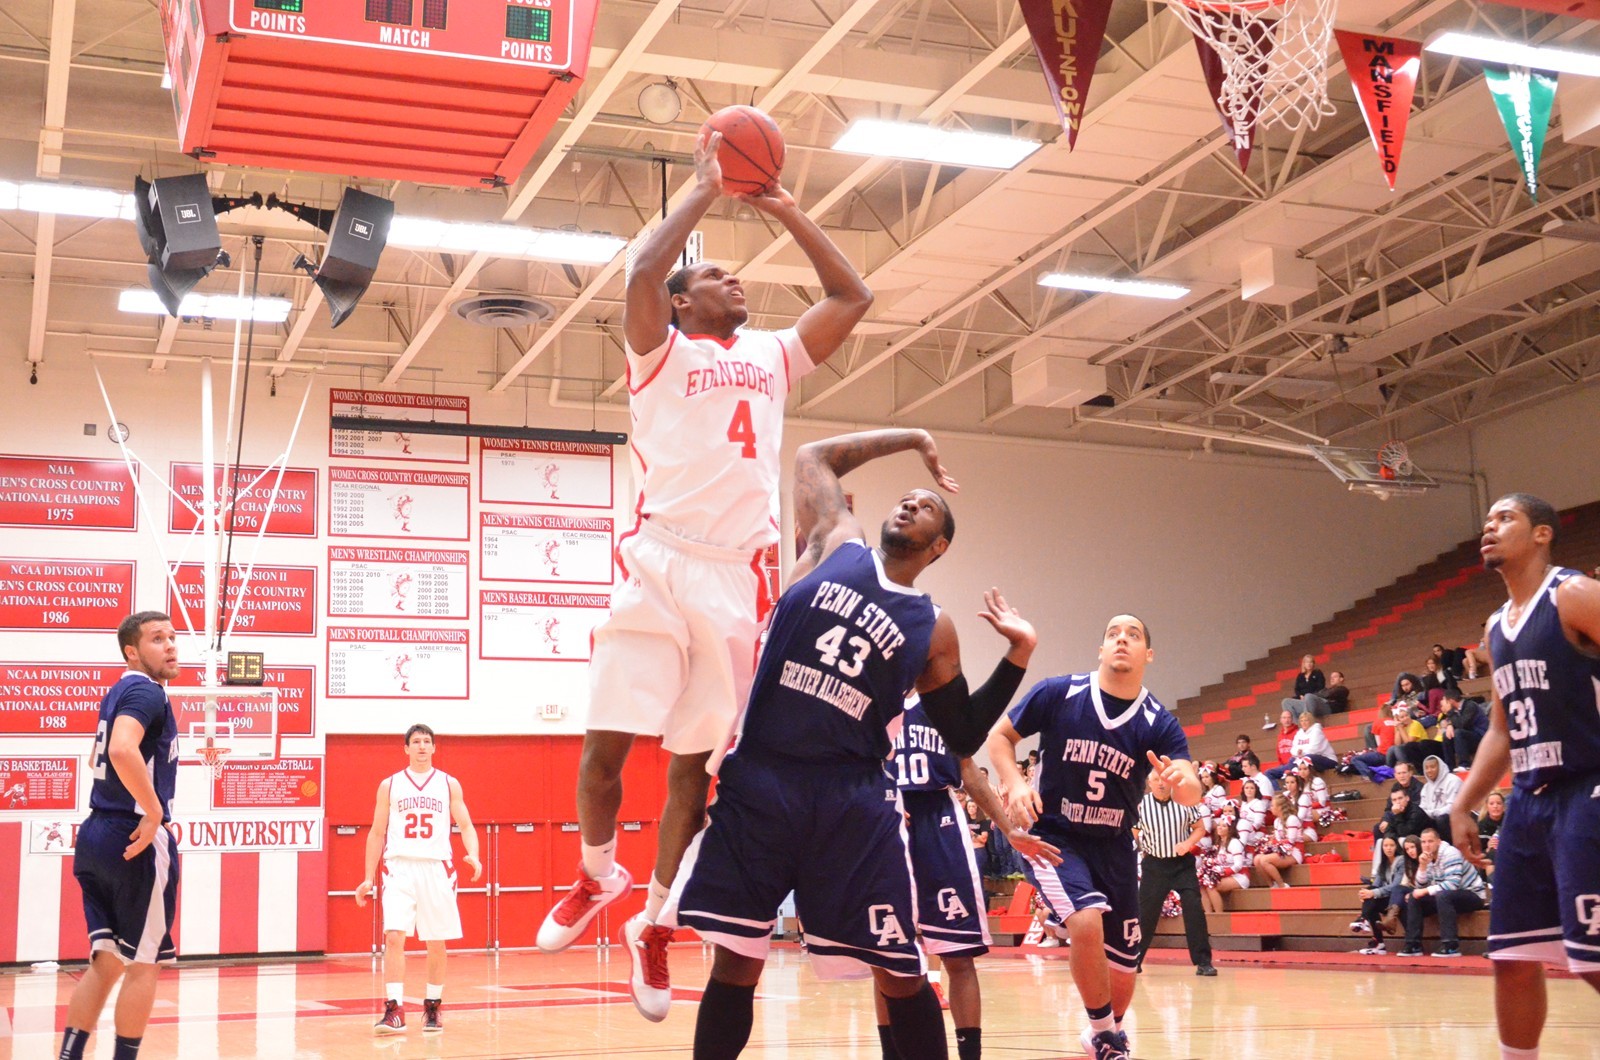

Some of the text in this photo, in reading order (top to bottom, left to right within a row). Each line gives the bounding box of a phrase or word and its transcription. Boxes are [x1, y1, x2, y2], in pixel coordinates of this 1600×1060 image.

[251, 11, 306, 33] POINTS
[380, 26, 430, 48] MATCH
[501, 40, 552, 62] POINTS
[1052, 0, 1080, 130] KUTZTOWN
[1363, 39, 1396, 174] MANSFIELD
[685, 360, 774, 401] EDINBORO
[333, 390, 467, 408] WOMEN'S CROSS COUNTRY CHAMPIONSHIPS
[727, 400, 757, 459] 4
[483, 438, 610, 454] WOMEN'S TENNIS CHAMPIONSHIPS
[48, 464, 75, 475] NAIA
[331, 469, 468, 485] WOMEN CROSS COUNTRY CHAMPIONSHIPS
[0, 477, 126, 492] EN'S CROSS COUNTRY
[55, 493, 120, 505] CHAMPIONS
[47, 508, 74, 520] 1975
[233, 516, 257, 528] 1976
[483, 514, 611, 530] MEN'S TENNIS CHAMPIONSHIPS
[331, 548, 467, 563] MEN'S WRESTLING CHAMPIONSHIPS
[11, 564, 104, 577] NCAA DIVISION II
[279, 572, 287, 581] II
[27, 581, 65, 592] CROSS
[67, 582, 124, 593] COUNTRY
[253, 586, 307, 598] COUNTRY
[0, 595, 118, 607] ATIONAL CHAMPIONS
[184, 598, 301, 611] NATNAL CHAMPIONS
[483, 592, 611, 607] MEN'S BASEBALL CHAMPIONSHIPS
[42, 611, 70, 623] 1986
[231, 615, 256, 627] 987
[810, 581, 906, 660] PENN STATE
[330, 628, 467, 642] MEN'S FOOTBALL CHAMPIONSHIPS
[815, 625, 871, 678] 43
[7, 669, 101, 680] NCAA DIVISION II
[277, 673, 285, 682] II
[23, 685, 62, 697] CROSS
[65, 685, 111, 697] COUNT
[779, 660, 872, 721] GREATER ALLEGHENY
[49, 701, 101, 711] CHAMPIO
[181, 702, 234, 712] NATINAL
[546, 704, 558, 714] EXIT
[39, 716, 67, 729] 1988
[1509, 697, 1538, 740] 33
[11, 760, 69, 771] BASKETBALL
[1062, 738, 1135, 780] PENN STATE
[895, 753, 929, 786] 10
[1086, 770, 1107, 801] 5
[397, 796, 443, 814] EDINBORO
[189, 820, 316, 846] UNIVERSITY
[404, 813, 433, 839] 25
